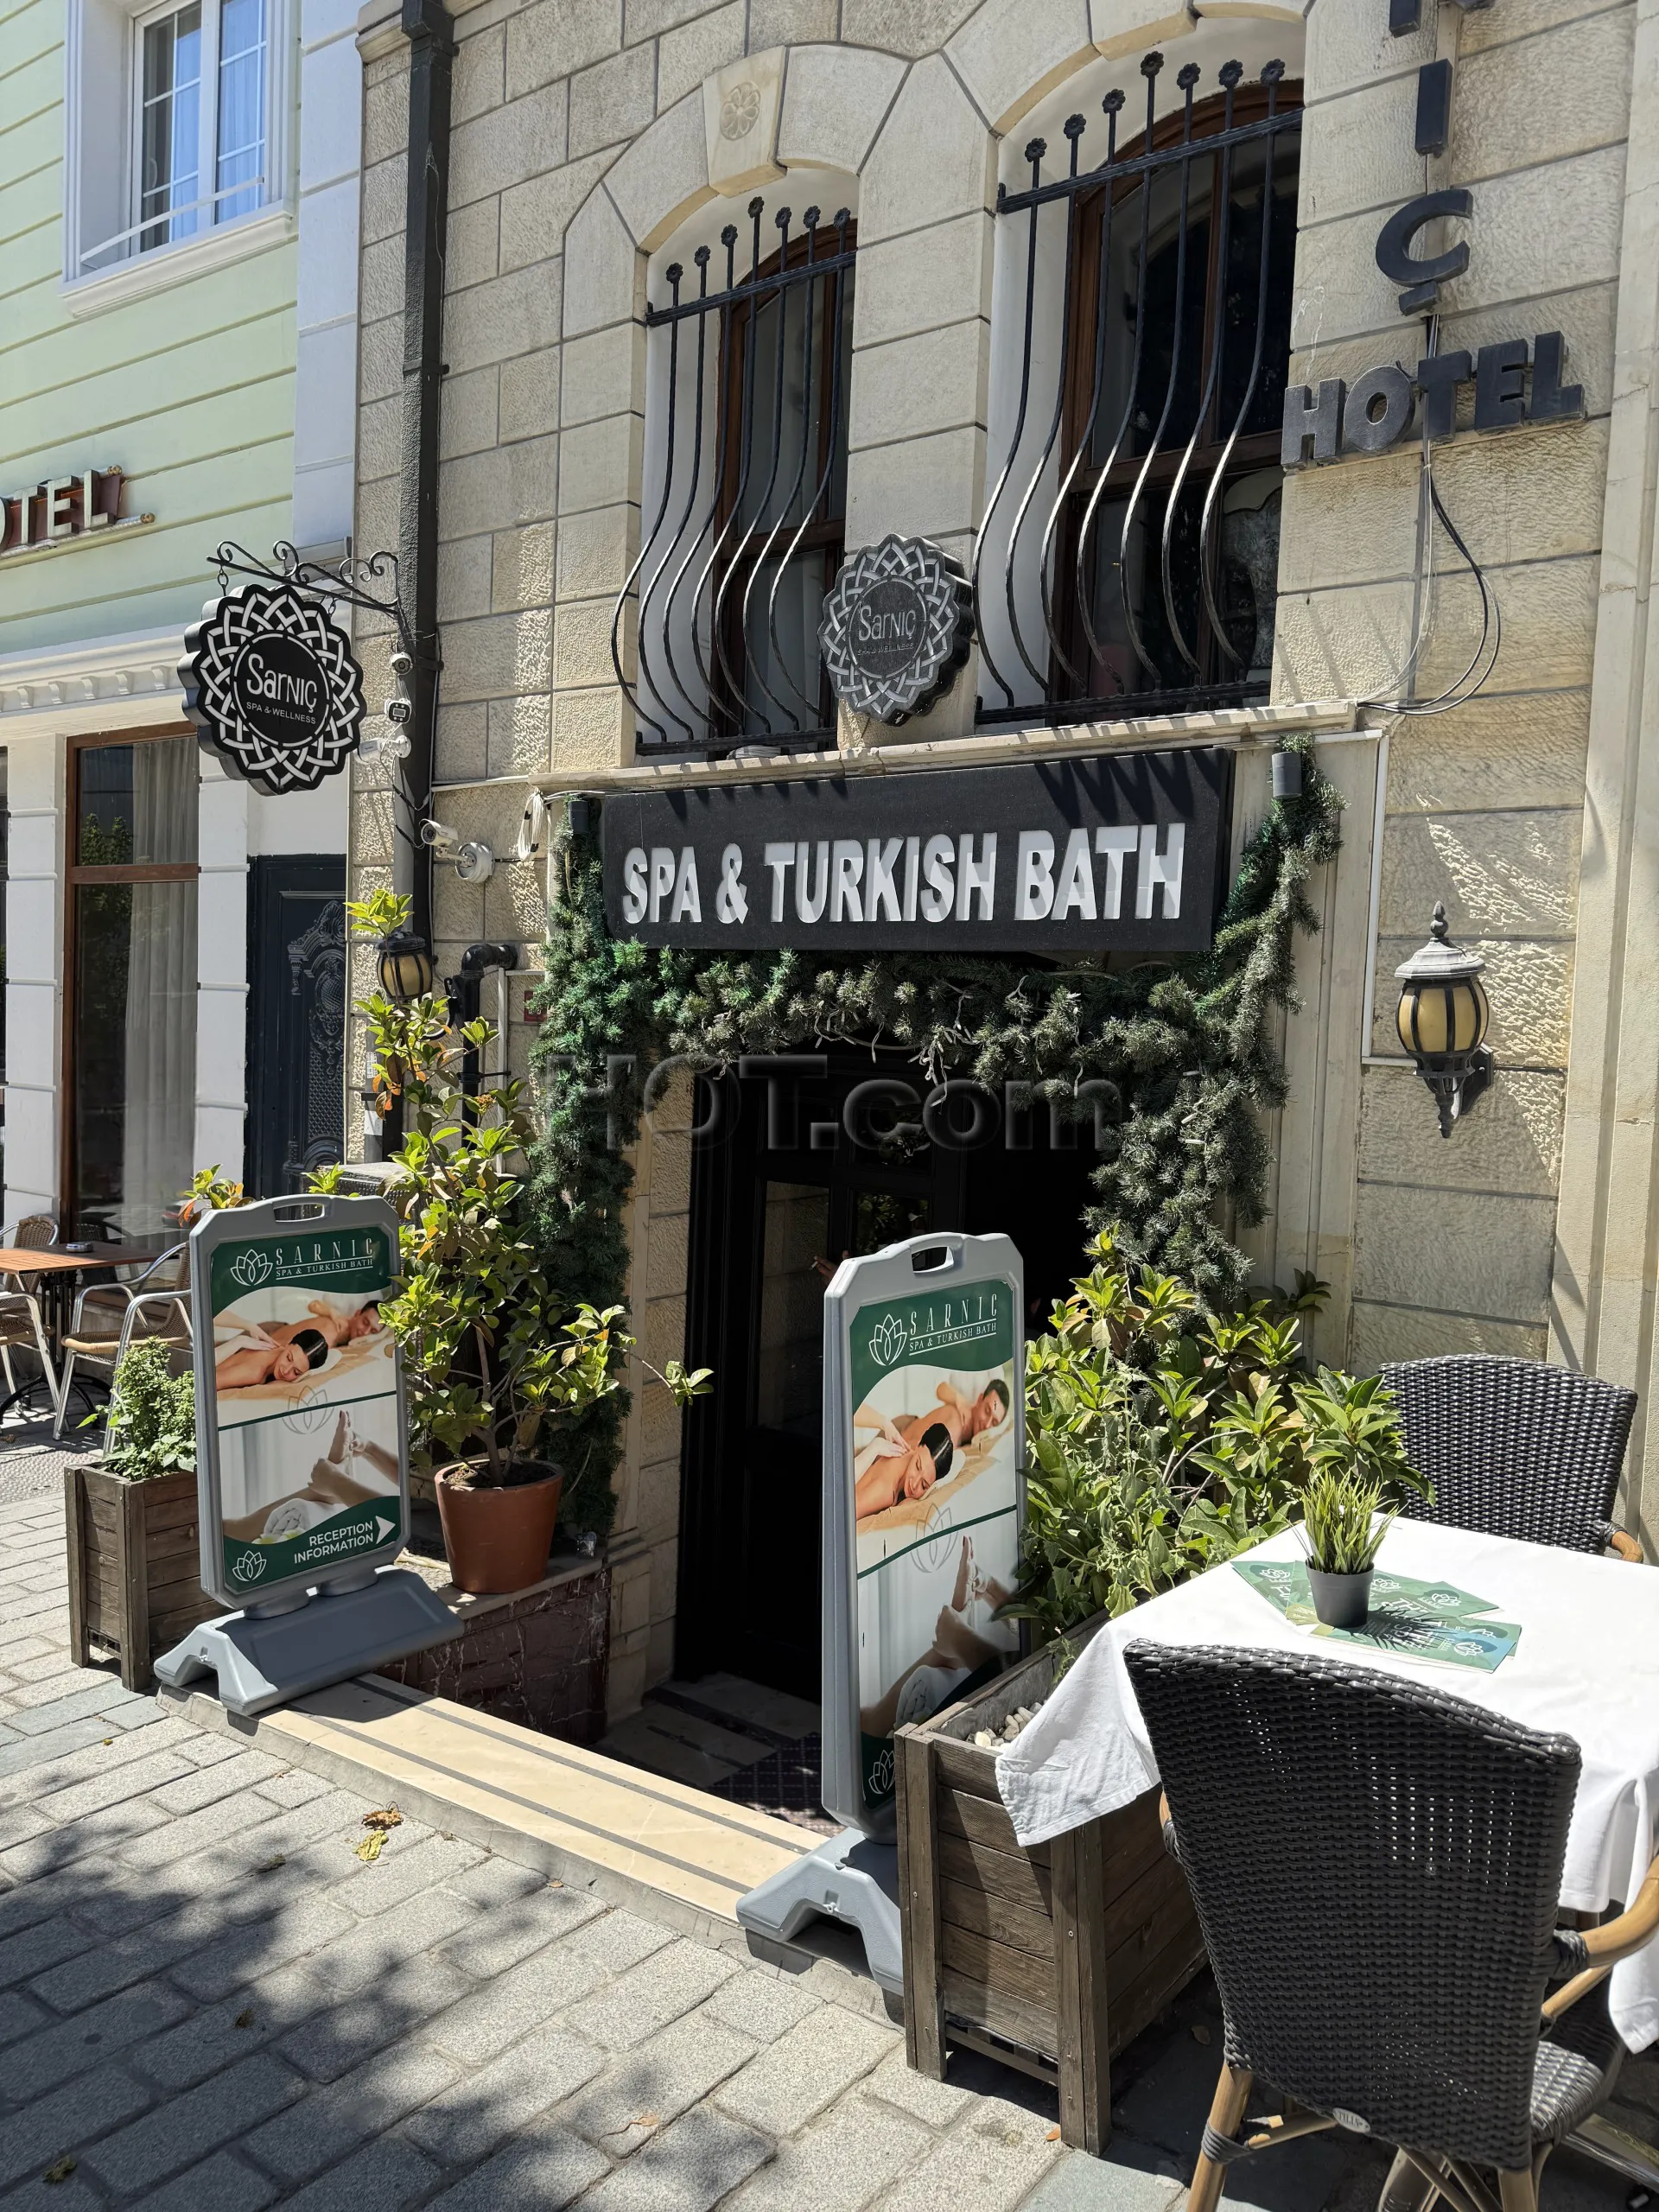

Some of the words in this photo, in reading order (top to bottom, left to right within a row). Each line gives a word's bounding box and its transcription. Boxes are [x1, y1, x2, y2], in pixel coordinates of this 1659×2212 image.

[1281, 330, 1586, 469] HOTEL
[246, 702, 263, 712] SPA
[272, 708, 316, 725] WELLNESS
[621, 847, 702, 924] SPA
[716, 842, 747, 925] &
[764, 832, 998, 924] TURKISH
[1014, 823, 1186, 922] BATH
[276, 1237, 372, 1266] SARNIC
[276, 1268, 292, 1277] SPA
[307, 1262, 346, 1274] TURKISH
[350, 1258, 373, 1268] BATH
[910, 1293, 997, 1336] SARNIC
[909, 1339, 925, 1351] SPA
[927, 1337, 933, 1347] &
[937, 1327, 973, 1344] TURKISH
[976, 1322, 997, 1335] BATH
[294, 1532, 374, 1564] INFORMATION
[308, 1520, 373, 1547] RECEPTION
